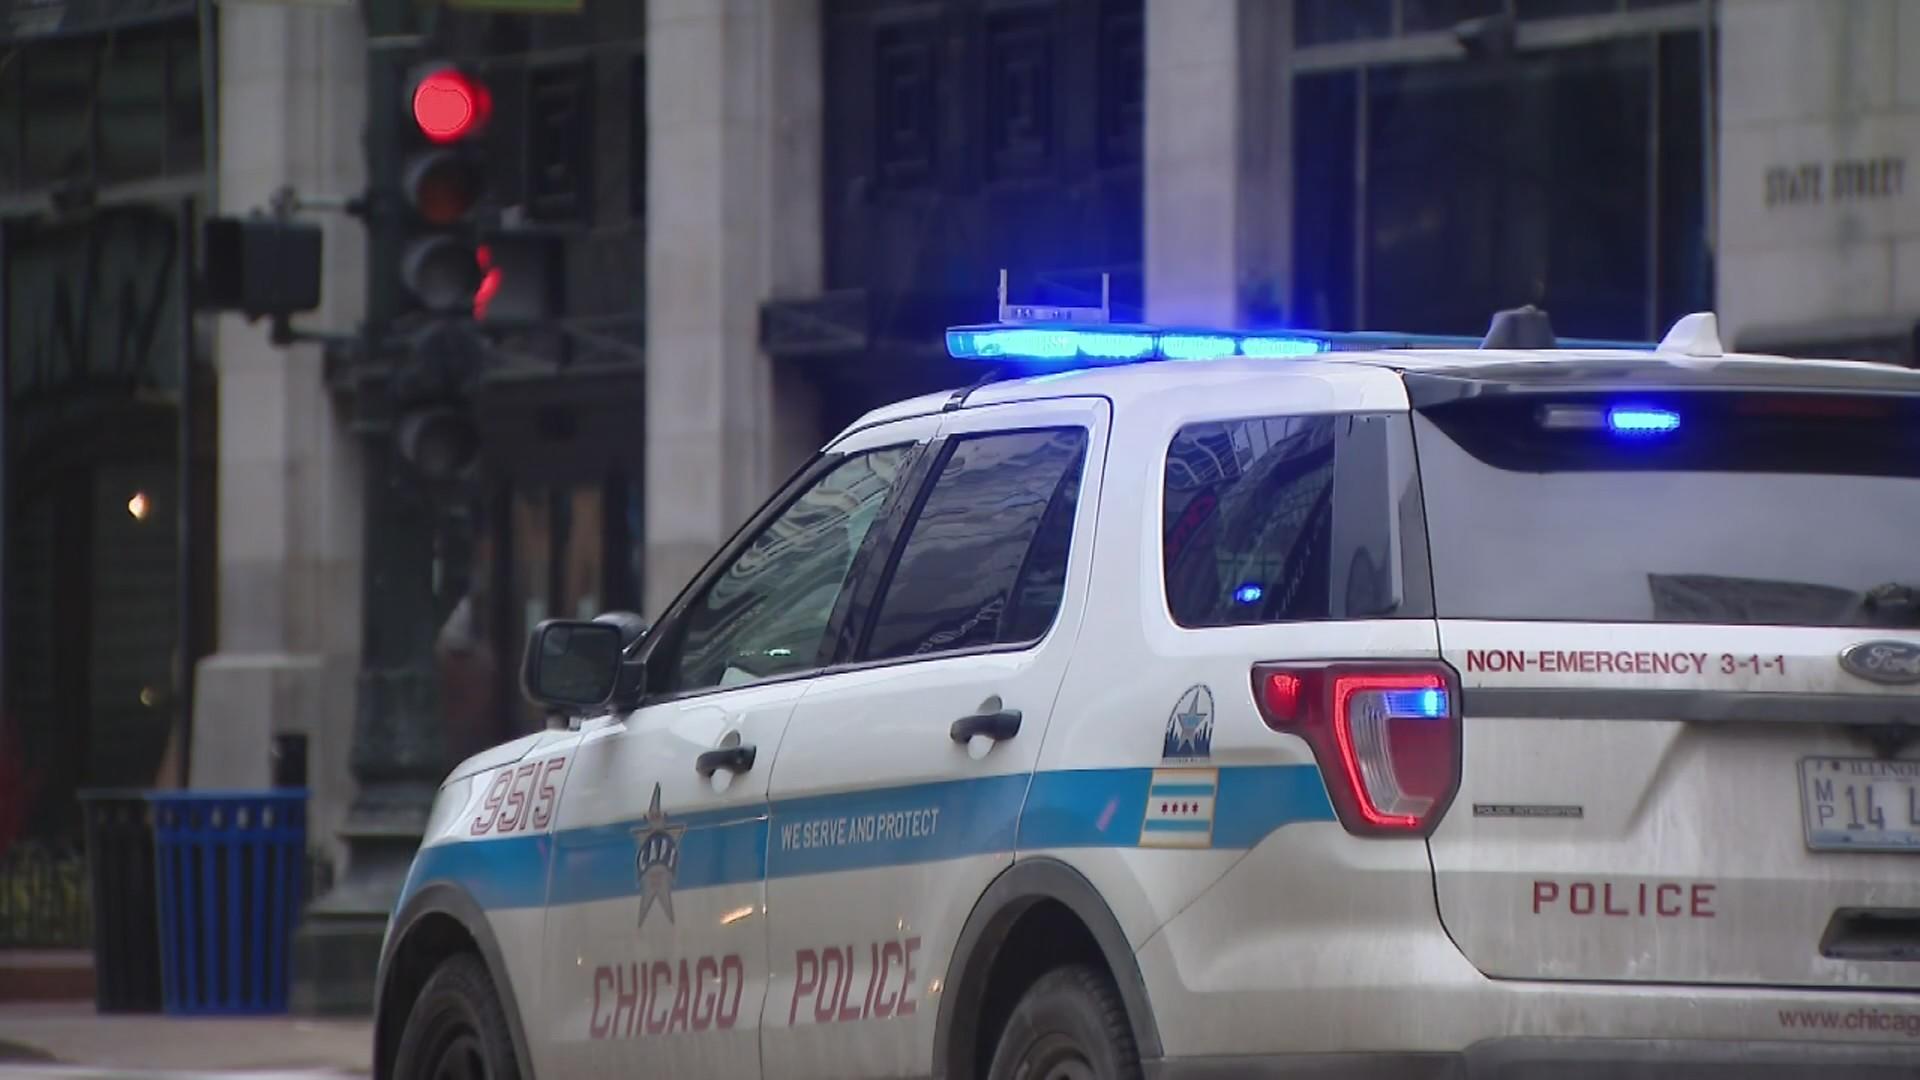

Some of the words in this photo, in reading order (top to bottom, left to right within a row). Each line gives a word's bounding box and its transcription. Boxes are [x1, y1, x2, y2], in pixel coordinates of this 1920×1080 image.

[1763, 163, 1823, 208] STATE
[1832, 156, 1905, 203] STREET
[1466, 650, 1708, 674] NON-EMERGENCY
[1720, 652, 1786, 675] 3-1-1
[471, 756, 566, 836] 9515
[781, 823, 801, 851] WE
[803, 816, 847, 849] SERVE
[849, 814, 875, 844] AND
[876, 808, 939, 841] PROTECT
[1532, 880, 1717, 918] POLICE
[590, 954, 744, 1039] CHICAGO
[788, 936, 922, 1027] POLICE
